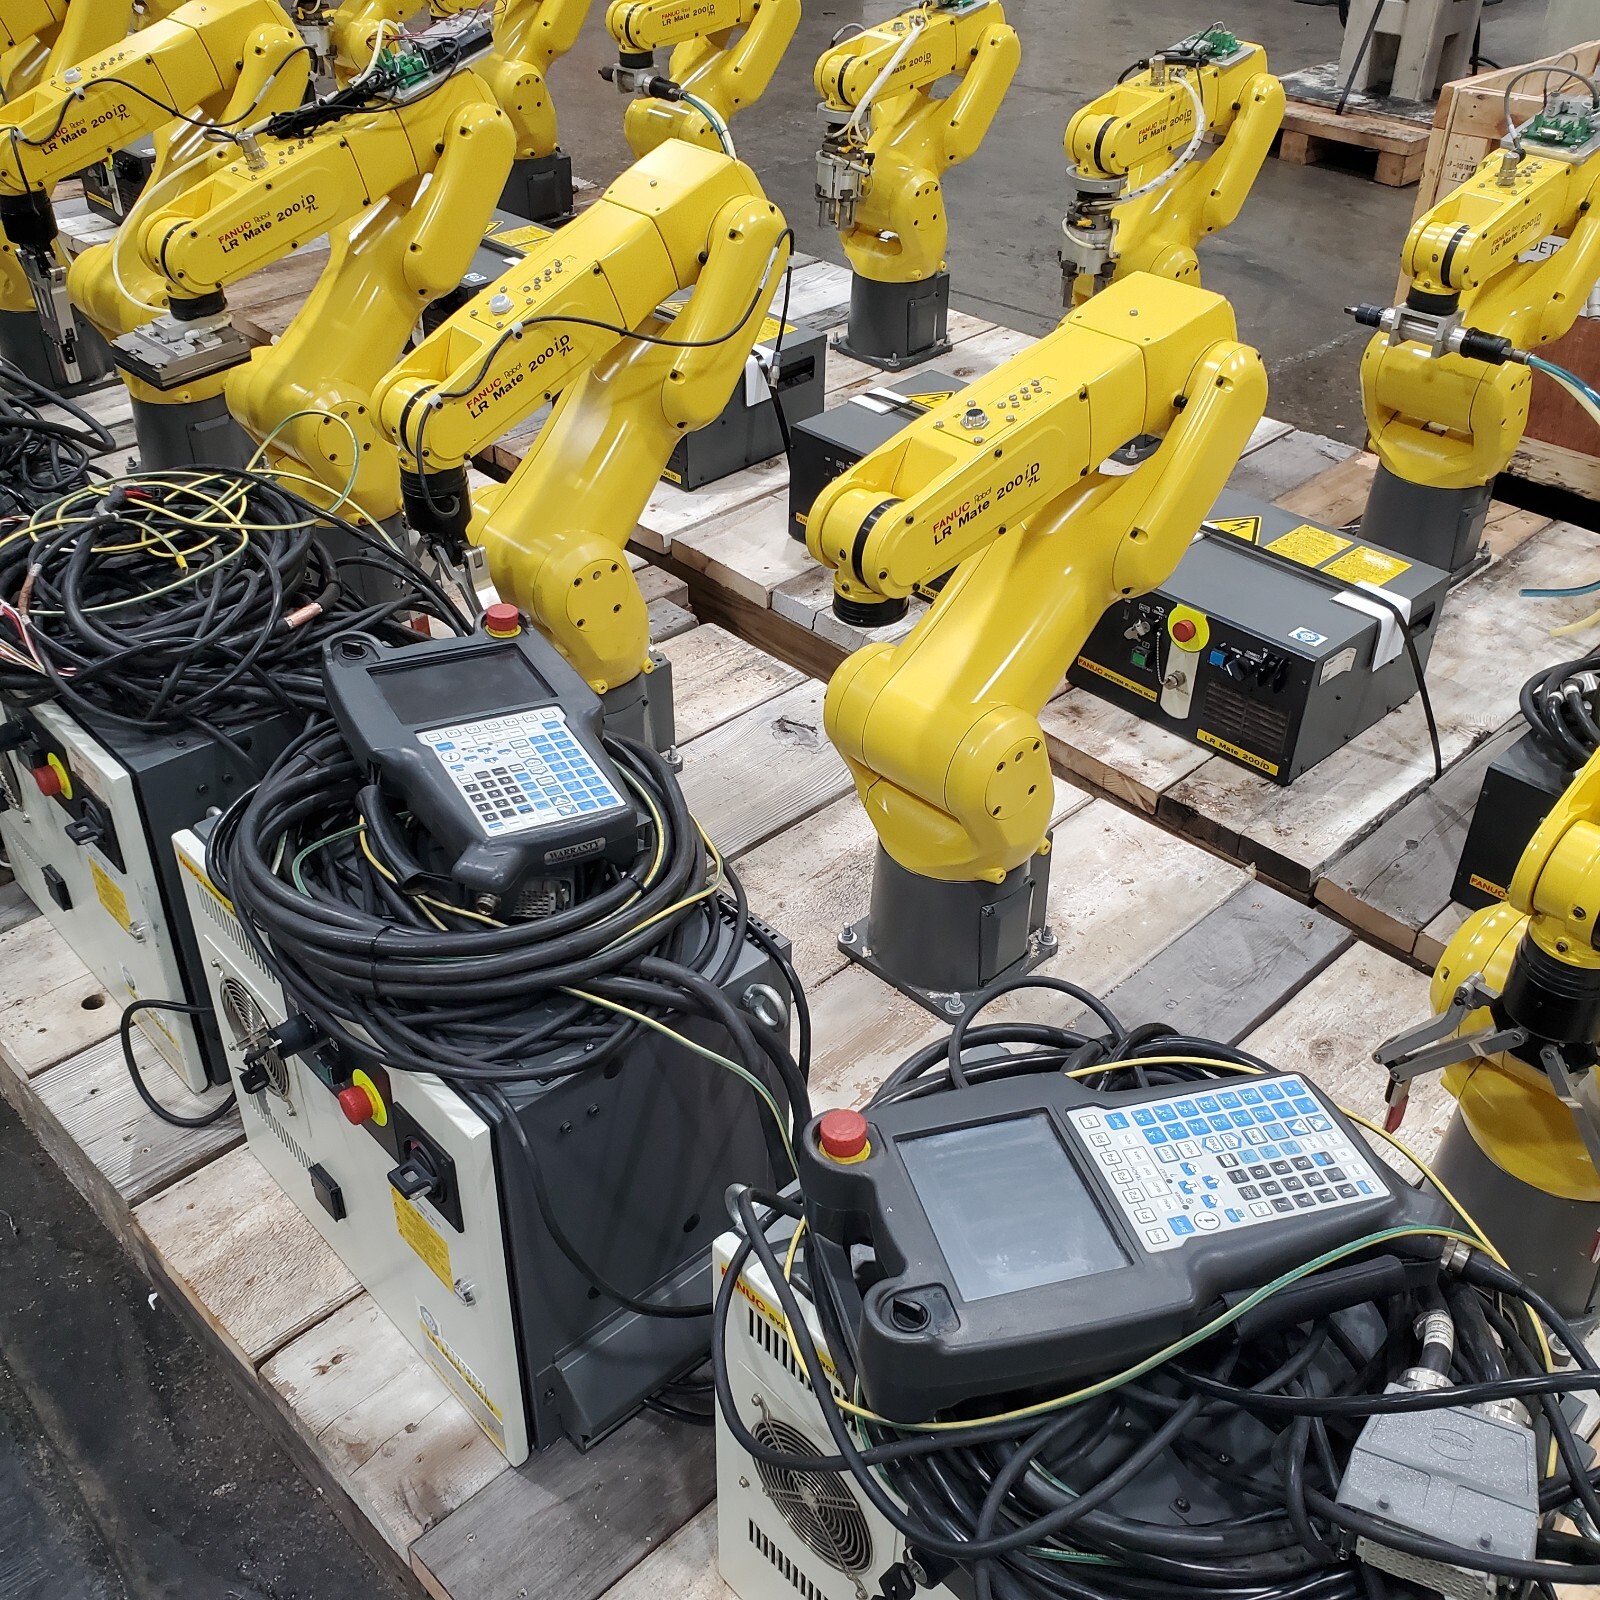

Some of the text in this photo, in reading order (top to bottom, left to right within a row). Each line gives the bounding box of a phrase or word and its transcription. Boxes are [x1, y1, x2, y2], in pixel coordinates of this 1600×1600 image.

[662, 10, 679, 19] FANUC
[674, 13, 689, 22] Mate
[42, 104, 126, 155] LR Mate 200iD
[69, 118, 85, 129] Robot
[1139, 122, 1157, 136] FANUC
[1139, 134, 1147, 144] LR
[1151, 125, 1166, 137] Mate
[305, 204, 319, 213] 7L
[218, 211, 271, 244] FANUC Robot
[222, 195, 315, 253] LR Mate 200iD
[1491, 245, 1500, 256] LR
[559, 345, 574, 356] 7L
[466, 362, 522, 409] FANUC Robot
[471, 335, 569, 419] LR Mate 200iD
[1027, 475, 1040, 487] 7L
[933, 487, 992, 533] FANUC Robot
[934, 463, 1039, 545] LR Mate 200iD
[1079, 659, 1103, 674] FANUC
[1104, 673, 1123, 684] SYSTEM
[1205, 736, 1269, 770] LR Mate 200iD
[550, 840, 600, 859] WARRANTY
[1471, 878, 1505, 897] FANUC
[722, 1266, 765, 1312] FNUC
